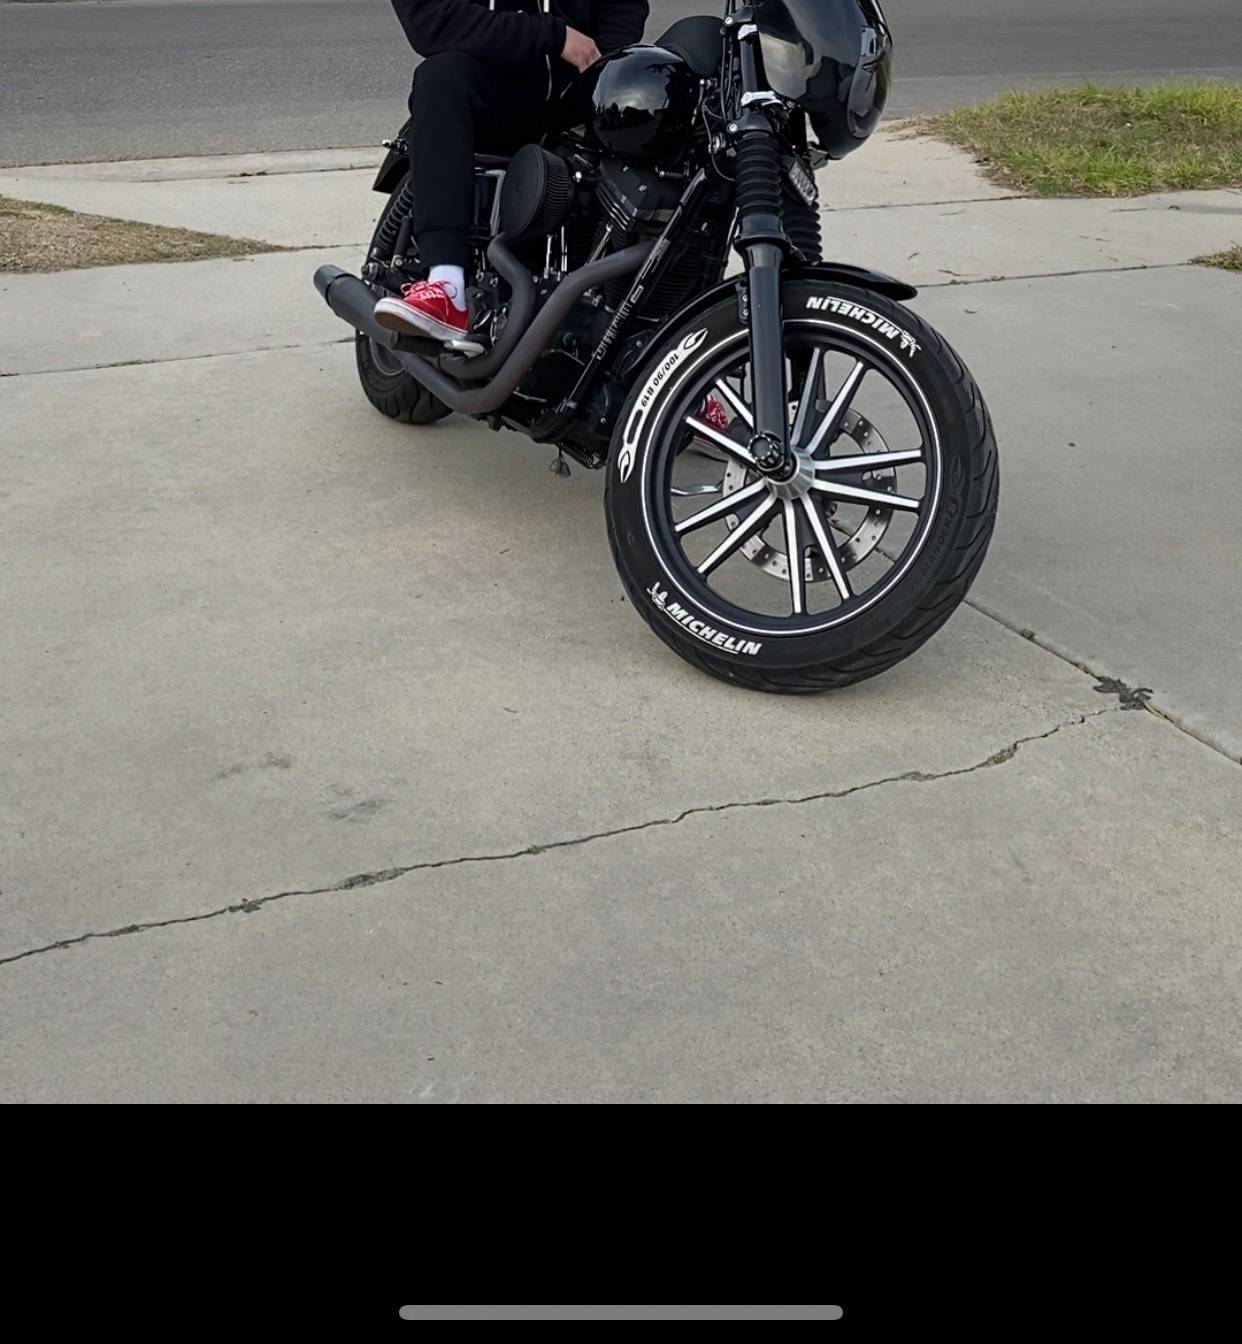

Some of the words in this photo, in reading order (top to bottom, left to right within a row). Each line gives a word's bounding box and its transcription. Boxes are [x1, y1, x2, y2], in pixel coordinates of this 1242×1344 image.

[805, 296, 900, 340] MICHELIN
[652, 353, 679, 387] 100/90
[666, 602, 763, 656] MICHELIN
